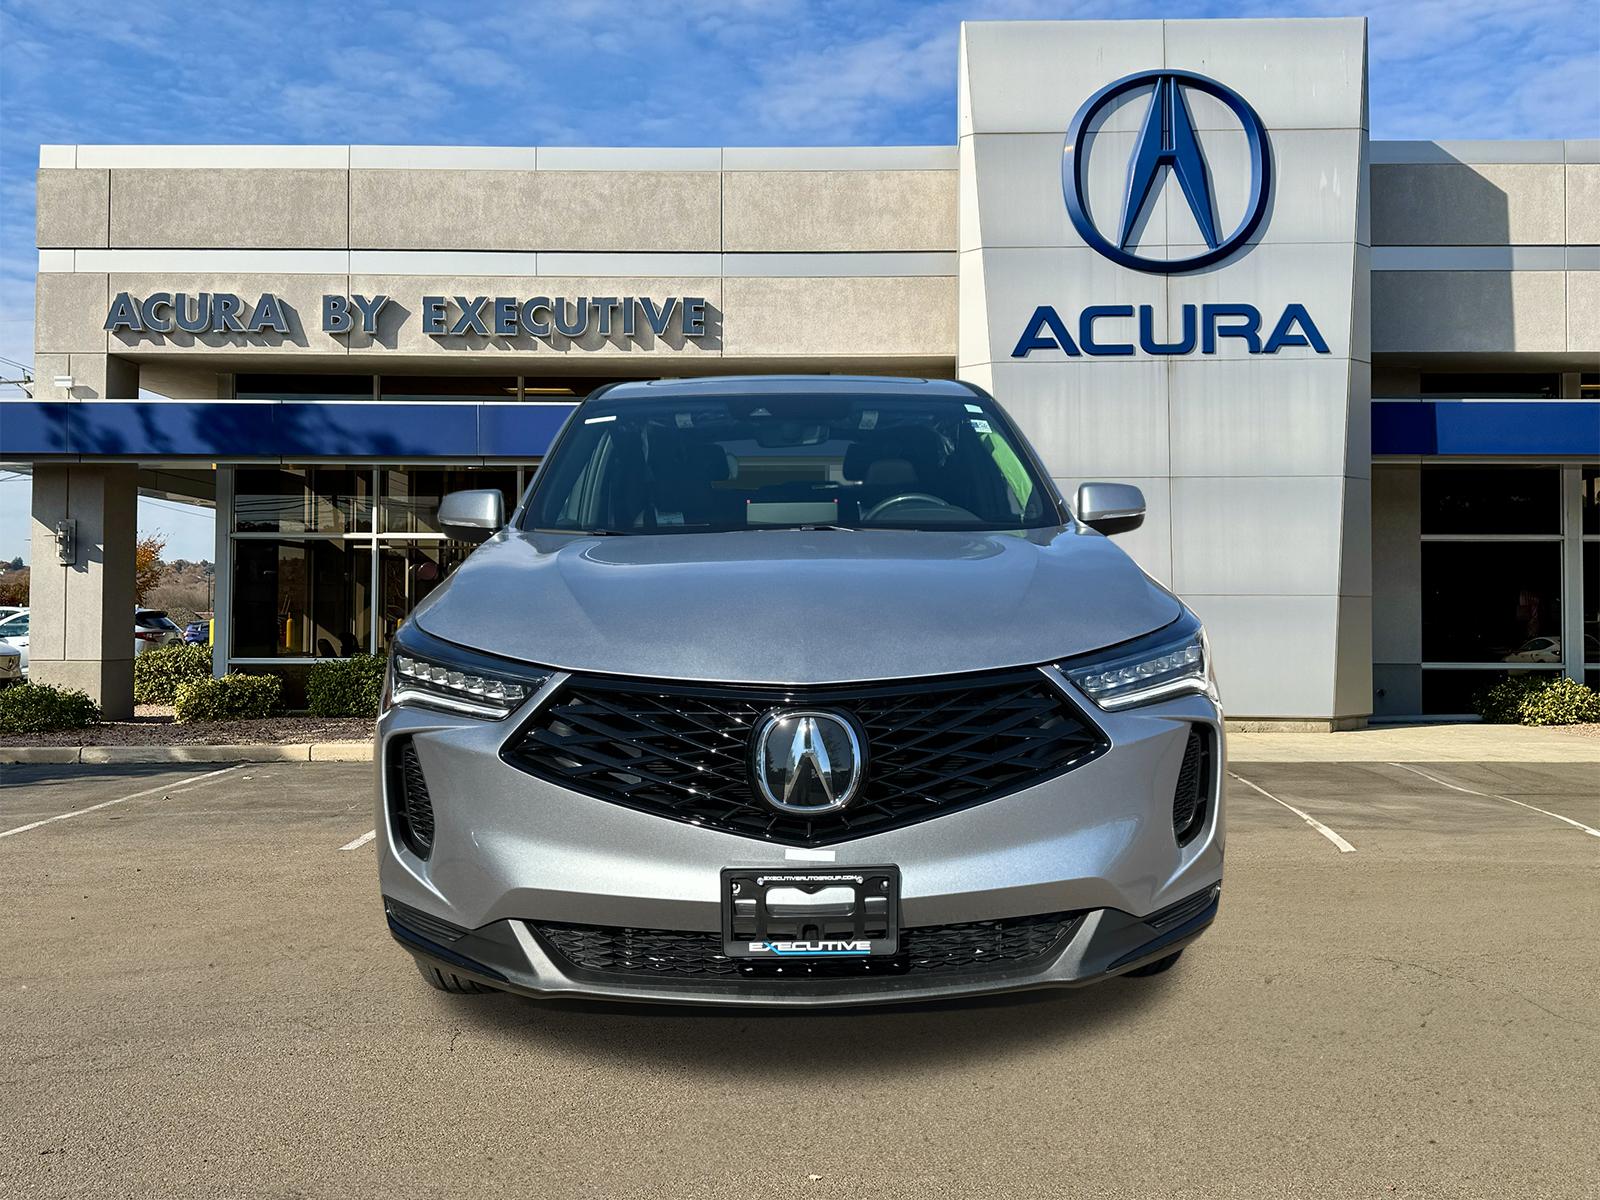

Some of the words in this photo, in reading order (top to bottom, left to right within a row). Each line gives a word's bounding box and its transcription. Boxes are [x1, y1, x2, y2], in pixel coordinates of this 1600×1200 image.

[103, 292, 289, 333] ACURA
[322, 294, 391, 335] BY
[422, 296, 706, 336] EXECUTIVE
[1011, 303, 1332, 358] ACURA
[749, 941, 871, 952] EXECUTIVE
